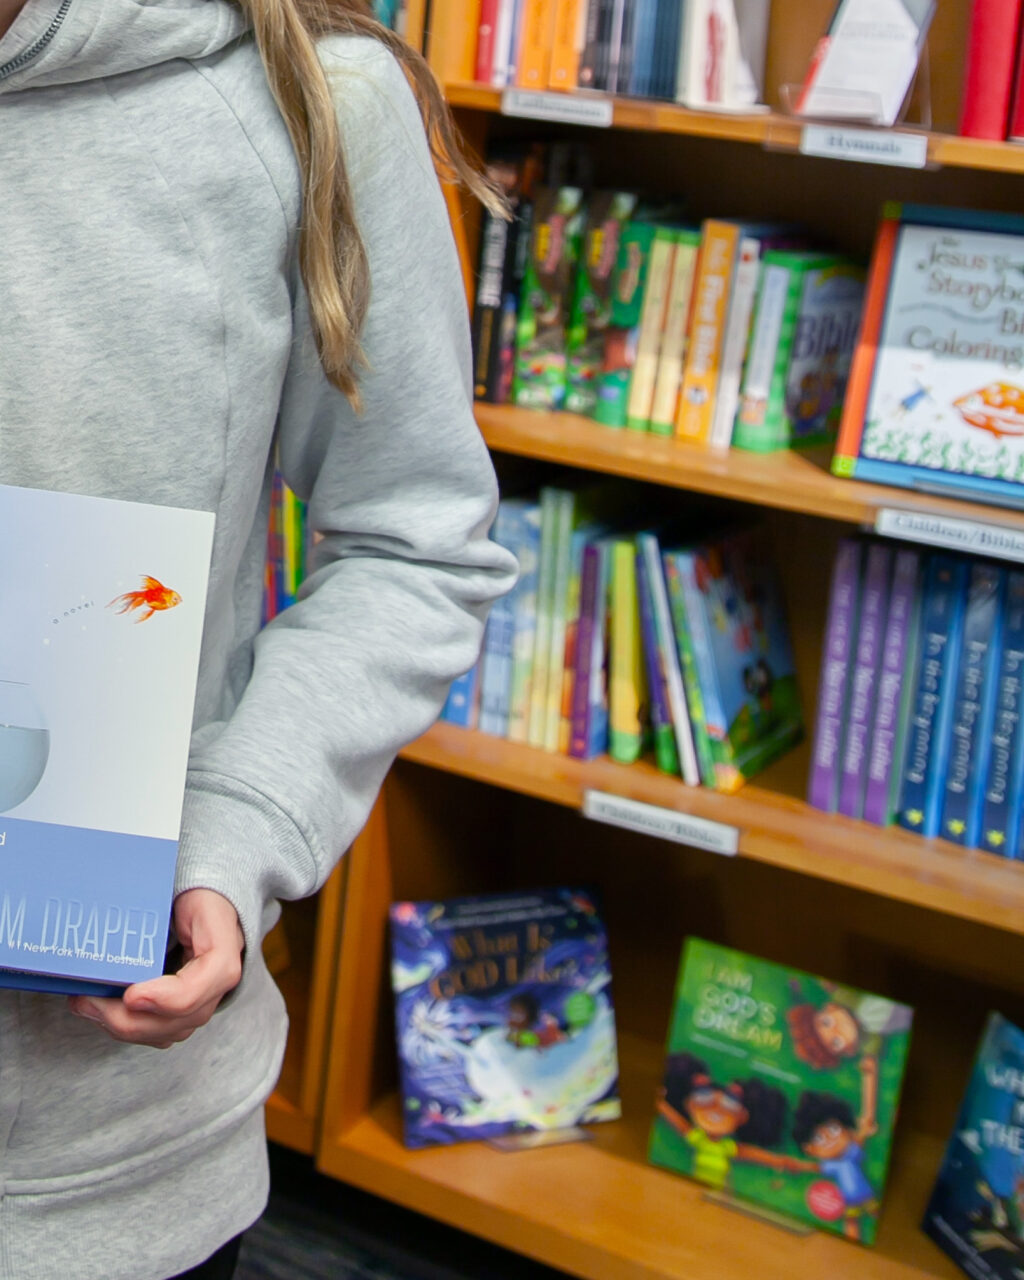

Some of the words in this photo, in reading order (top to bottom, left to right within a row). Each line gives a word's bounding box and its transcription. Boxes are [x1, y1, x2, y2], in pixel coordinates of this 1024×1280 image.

[917, 241, 988, 270] Jesus
[906, 324, 1024, 375] Coloring
[39, 896, 161, 963] DRAPER
[23, 942, 49, 954] New
[50, 944, 73, 958] York
[74, 948, 104, 962] Times
[106, 953, 155, 968] bestseller
[428, 958, 500, 1001] GOD
[716, 968, 754, 994] AM
[701, 983, 776, 1027] GOD'S
[692, 1006, 784, 1052] DREAM
